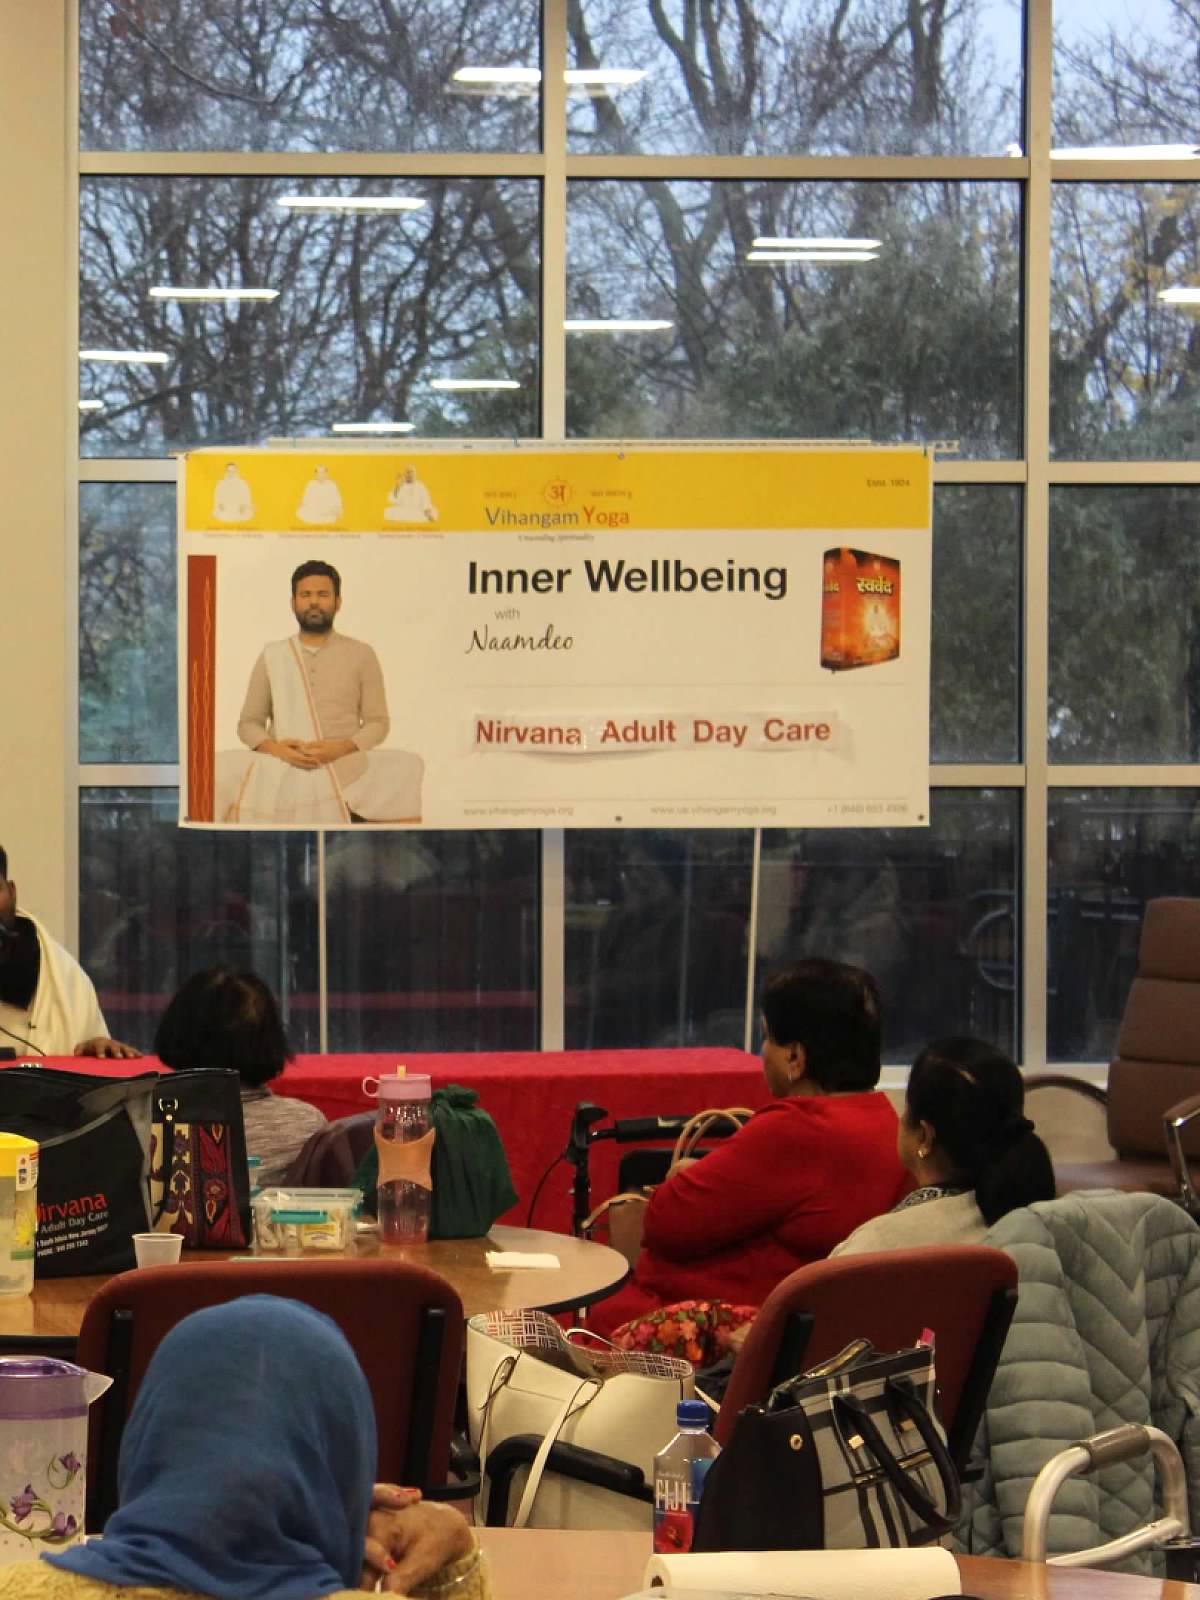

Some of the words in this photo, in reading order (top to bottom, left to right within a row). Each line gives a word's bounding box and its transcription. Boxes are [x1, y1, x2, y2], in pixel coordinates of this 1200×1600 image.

[485, 505, 579, 529] Vihangam
[582, 505, 631, 528] Yoga
[468, 560, 573, 595] Inner
[584, 559, 789, 601] Wellbeing
[494, 606, 521, 622] with
[464, 623, 574, 655] Naamdeo
[475, 719, 583, 745] Nirvana
[600, 719, 677, 743] Adult
[692, 719, 748, 749] Day
[762, 718, 832, 742] Care
[68, 1217, 86, 1228] Day
[88, 1210, 109, 1222] Care
[656, 1479, 688, 1512] FIJI
